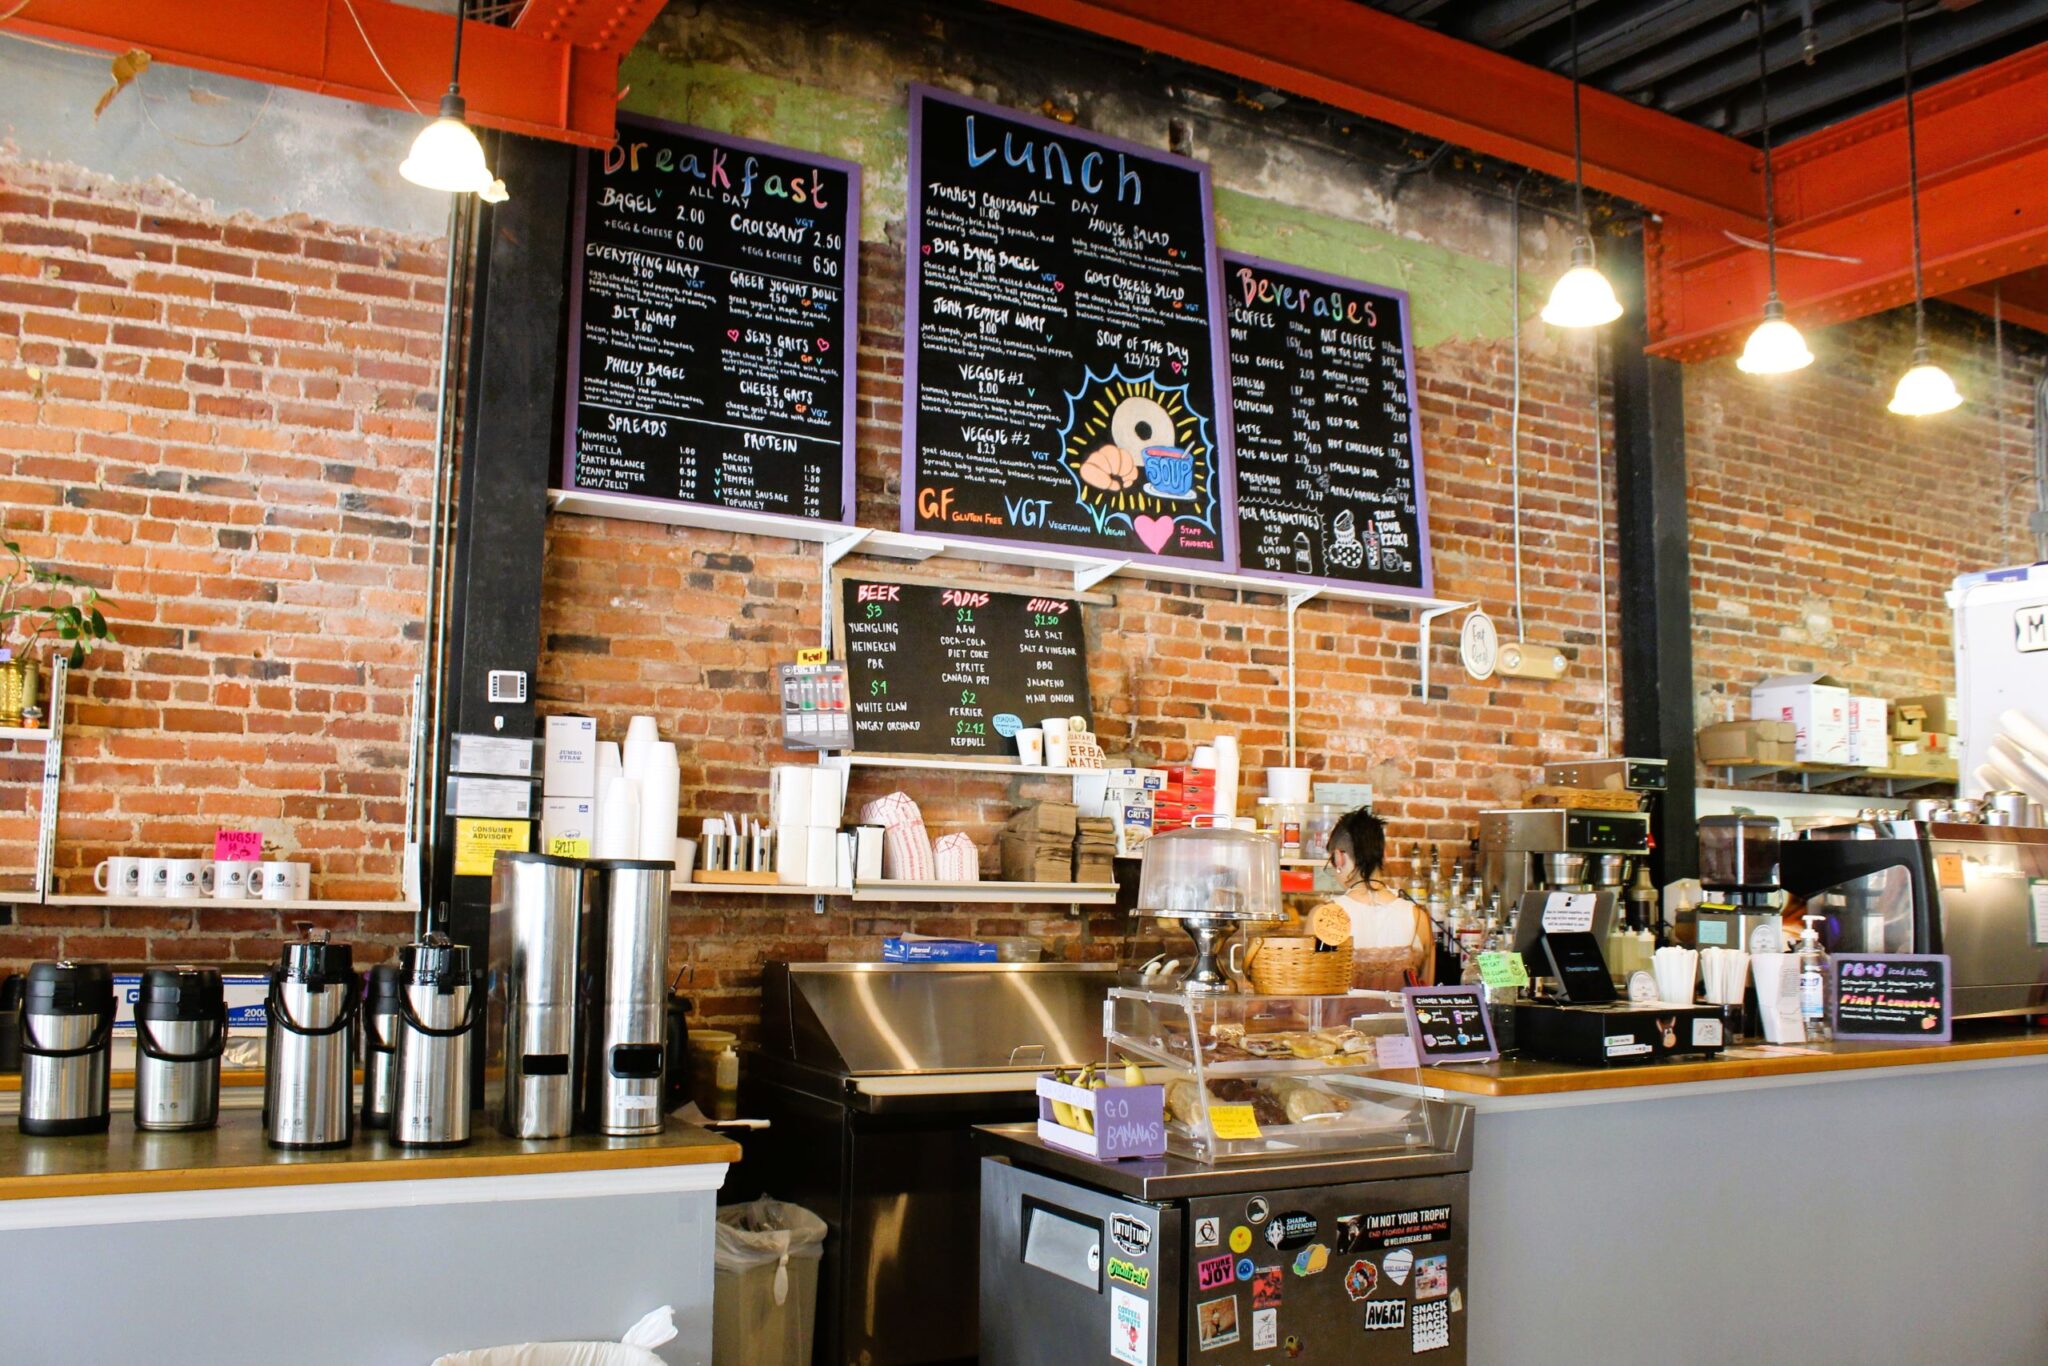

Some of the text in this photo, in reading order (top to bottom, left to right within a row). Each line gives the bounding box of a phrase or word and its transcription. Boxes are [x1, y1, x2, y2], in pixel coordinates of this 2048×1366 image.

[966, 115, 1142, 206] Lunch
[597, 187, 657, 214] BAGEL
[690, 186, 750, 210] ALL DAY
[929, 182, 1040, 217] TURKEY CROISSANT
[1028, 190, 1099, 216] ALL DAY
[676, 205, 706, 225] 2.00
[730, 212, 842, 250] CROISSANT VGT 2.50
[1088, 218, 1126, 236] HOUSE
[1133, 225, 1170, 246] SALAD
[676, 231, 704, 251] 6.00
[586, 242, 700, 279] EVERYTHING WRAP
[932, 237, 1040, 272] BIG BANG BAGEL
[633, 266, 705, 289] 9.00 VGT
[1085, 269, 1185, 300] GOAT CHEESE SALAD
[730, 270, 838, 302] GREEK YOGURT BOWL
[1236, 267, 1377, 328] Beverages
[611, 304, 677, 329] BLT WRAP
[933, 297, 1046, 334] JERK TEMPEH WRAP
[1235, 308, 1275, 328] COFFEE
[745, 329, 809, 353] SEXY GRITS
[1097, 329, 1122, 349] SOUP
[1127, 337, 1138, 351] OF
[1141, 339, 1163, 354] THE
[1320, 328, 1376, 350] NOT COFFEE
[604, 355, 685, 380] PHILLY BAGEL
[1231, 353, 1285, 370] ICED COFFEE
[958, 363, 1025, 386] VEGGIE #1
[740, 381, 813, 405] CHEESE GRITS
[608, 413, 667, 438] SPREADS
[1237, 424, 1261, 435] LATTE
[582, 430, 618, 444] HUMMUS
[743, 432, 798, 453] PROTEIN
[961, 426, 1031, 446] VEGGIE #2
[582, 442, 622, 456] NUTELLA
[1031, 450, 1050, 461] VGT
[581, 454, 645, 470] EARTH BALANCE
[722, 452, 750, 464] BACON
[581, 465, 645, 482] PEANUT BUTTER
[722, 462, 753, 474] TURKEY
[1149, 459, 1192, 490] SOUP
[581, 476, 629, 490] JAM/JELLY
[723, 473, 754, 486] TEMPEH
[678, 489, 695, 499] free
[722, 487, 789, 503] VEGAN SAUSAGE
[723, 497, 820, 517] TOFURKEY 1.50
[918, 487, 955, 521] GF
[952, 511, 983, 523] GLUTEN
[984, 513, 1003, 525] FREE
[1004, 495, 1053, 529] VGT
[1090, 503, 1107, 534] V
[1239, 506, 1320, 531] MILK ALTERNATIVES
[1373, 510, 1396, 521] TAKE
[1377, 522, 1401, 533] YOUR
[1381, 533, 1408, 547] PICK!
[1265, 558, 1281, 570] SOY
[942, 590, 990, 608] SODAS
[1027, 598, 1069, 614] CHIPS
[866, 603, 883, 619] $3
[957, 607, 974, 622] $1
[1034, 613, 1059, 627] $1.50
[848, 622, 899, 635] YUENGLING
[956, 625, 975, 634] A&W
[1024, 629, 1063, 640] SEA SALT
[852, 641, 896, 653] HEINEKEN
[940, 636, 986, 647] COCA-COLA
[948, 649, 989, 659] DIET COKE
[1020, 644, 1077, 656] SALT & VINEGAR
[867, 658, 884, 669] PBR
[955, 662, 985, 673] SPRITE
[1036, 661, 1053, 671] BBQ
[942, 673, 989, 685] CANADA DRY
[961, 689, 977, 705] $2
[1026, 694, 1074, 704] MAUI ONION
[856, 702, 908, 713] WHITE CLAW
[950, 707, 984, 717] PERRIER
[856, 721, 920, 731] ANGRY ORCHARD
[951, 736, 986, 747] REDBULL
[1070, 745, 1103, 758] ERBA
[1126, 811, 1150, 820] GRITS
[472, 826, 513, 834] CONSUMER
[219, 832, 257, 845] MUGS!
[1841, 963, 1887, 977] PB+J
[1888, 966, 1905, 976] iced
[1841, 994, 1873, 1006] Pink
[1104, 1099, 1129, 1118] GO
[1106, 1121, 1160, 1150] BANANAS
[1286, 1216, 1307, 1224] SHARK
[1287, 1222, 1317, 1231] DEFENDER
[1367, 1207, 1450, 1230] I'M NOT YOUR TROPHY
[1113, 1221, 1150, 1246] INTUITION
[1201, 1258, 1231, 1271] FUTURE
[1202, 1266, 1231, 1286] JOY
[1368, 1304, 1404, 1326] AVERT
[1413, 1301, 1447, 1315] SNACK
[1413, 1309, 1448, 1324] SNACK
